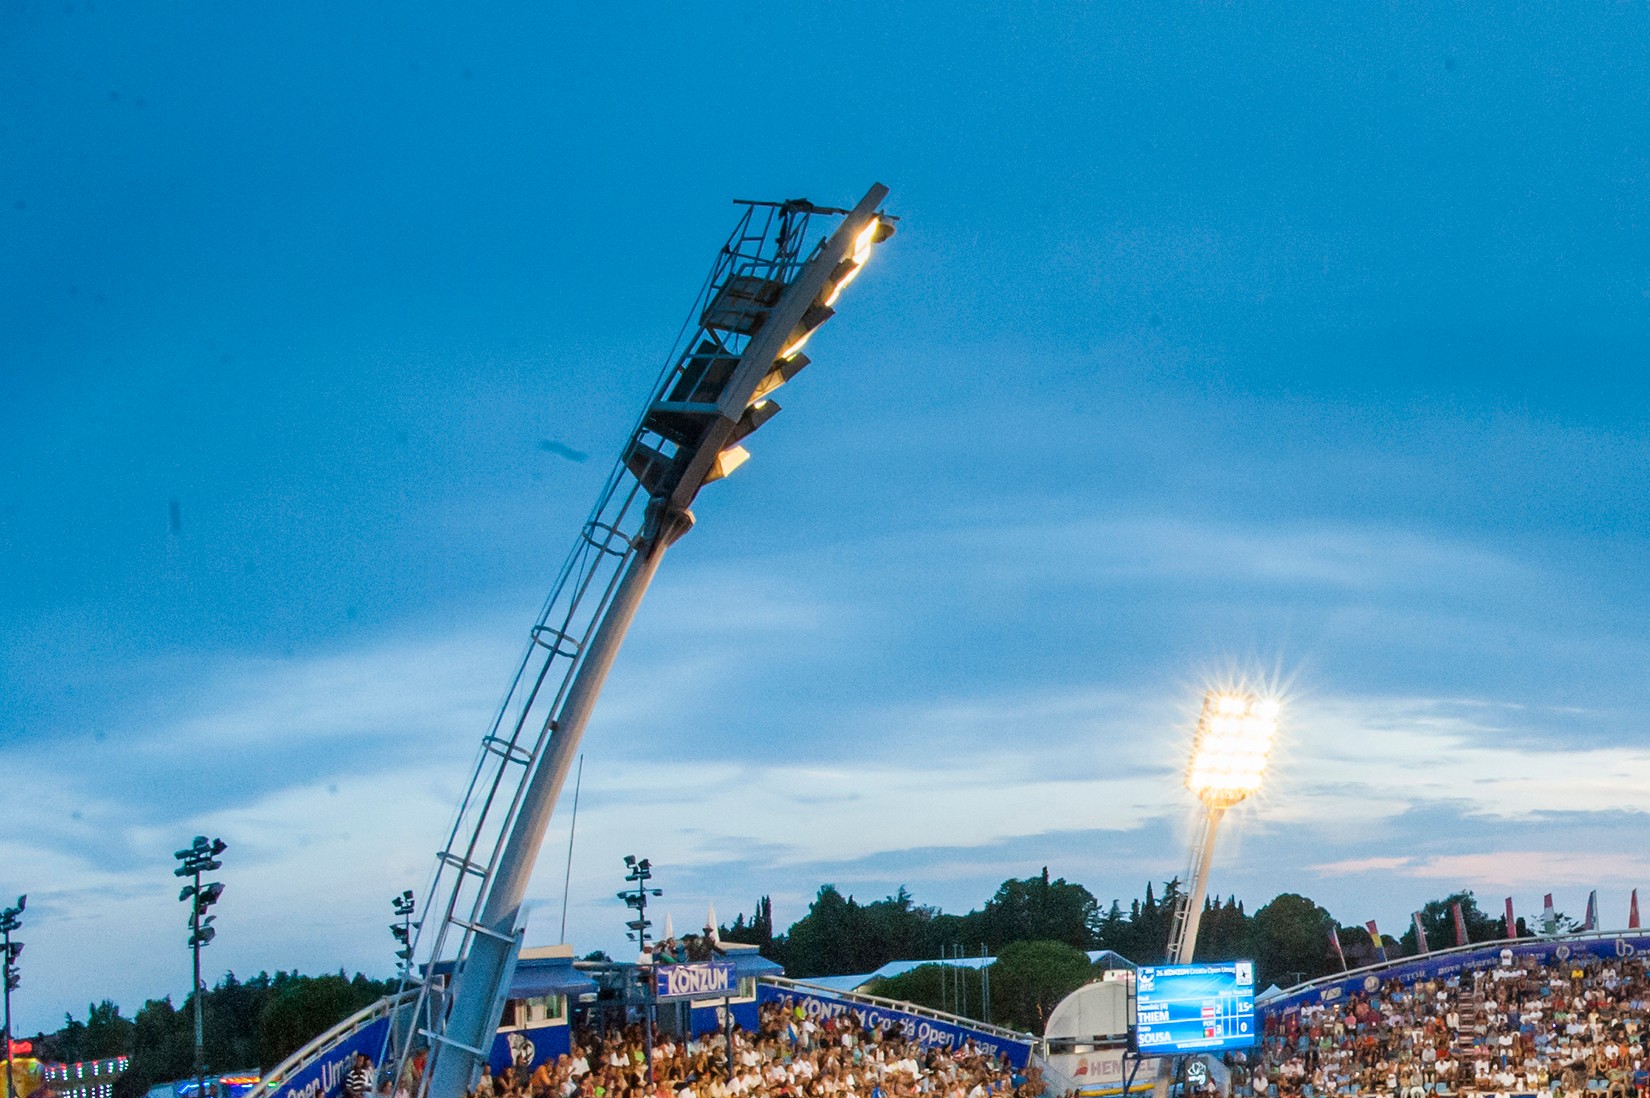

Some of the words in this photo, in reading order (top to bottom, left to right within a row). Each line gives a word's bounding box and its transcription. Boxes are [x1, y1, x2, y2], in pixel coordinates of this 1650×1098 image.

[667, 965, 729, 994] KONZUM
[1138, 1011, 1170, 1022] THIEM
[1138, 1031, 1171, 1044] SOUSA
